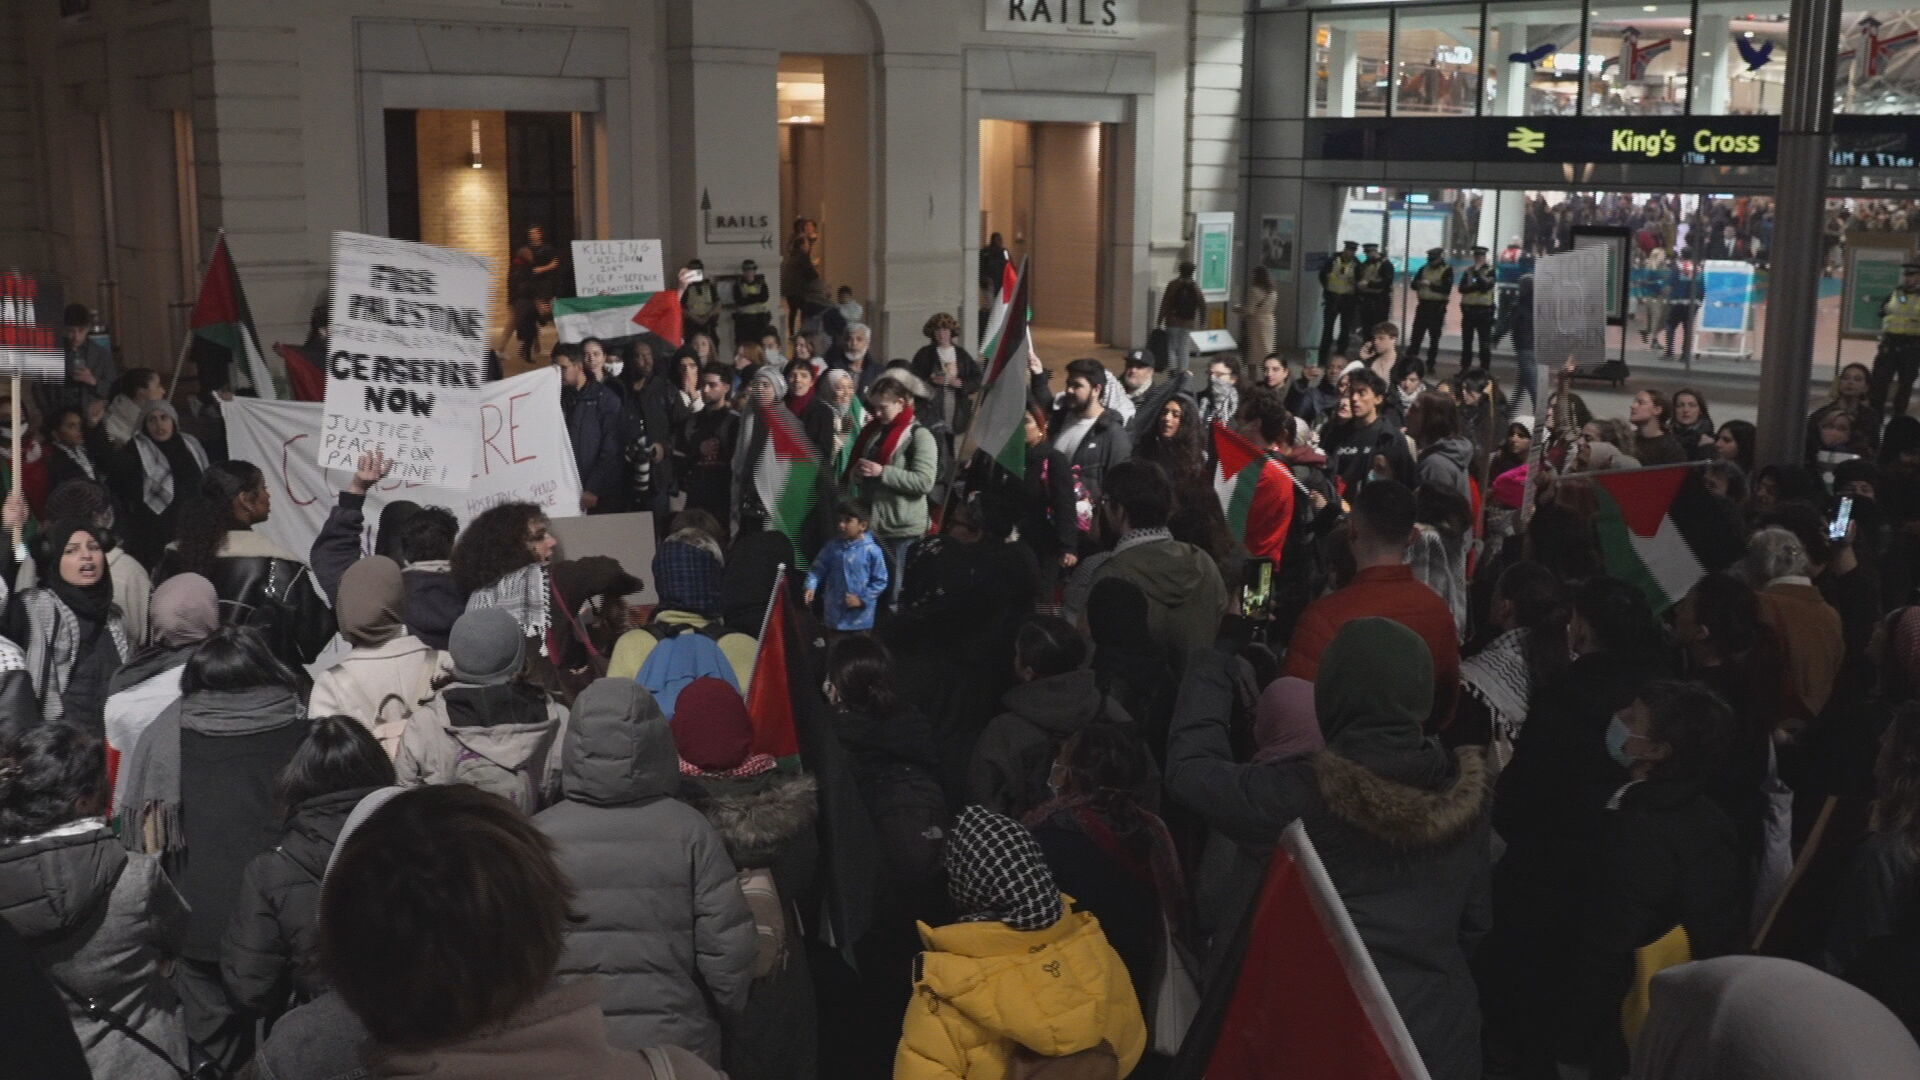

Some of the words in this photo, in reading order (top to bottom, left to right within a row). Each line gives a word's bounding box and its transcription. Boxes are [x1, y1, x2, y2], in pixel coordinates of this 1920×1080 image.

[1008, 0, 1117, 26] RAILS
[1611, 129, 1676, 157] King's
[1693, 129, 1760, 153] Cross
[716, 214, 769, 228] RAILS
[368, 264, 438, 294] FREE
[348, 294, 485, 340] PALESTINE
[327, 350, 481, 390] CEASEFIRE
[363, 385, 436, 418] NOW
[325, 433, 386, 453] PEACE
[397, 444, 434, 463] FOR
